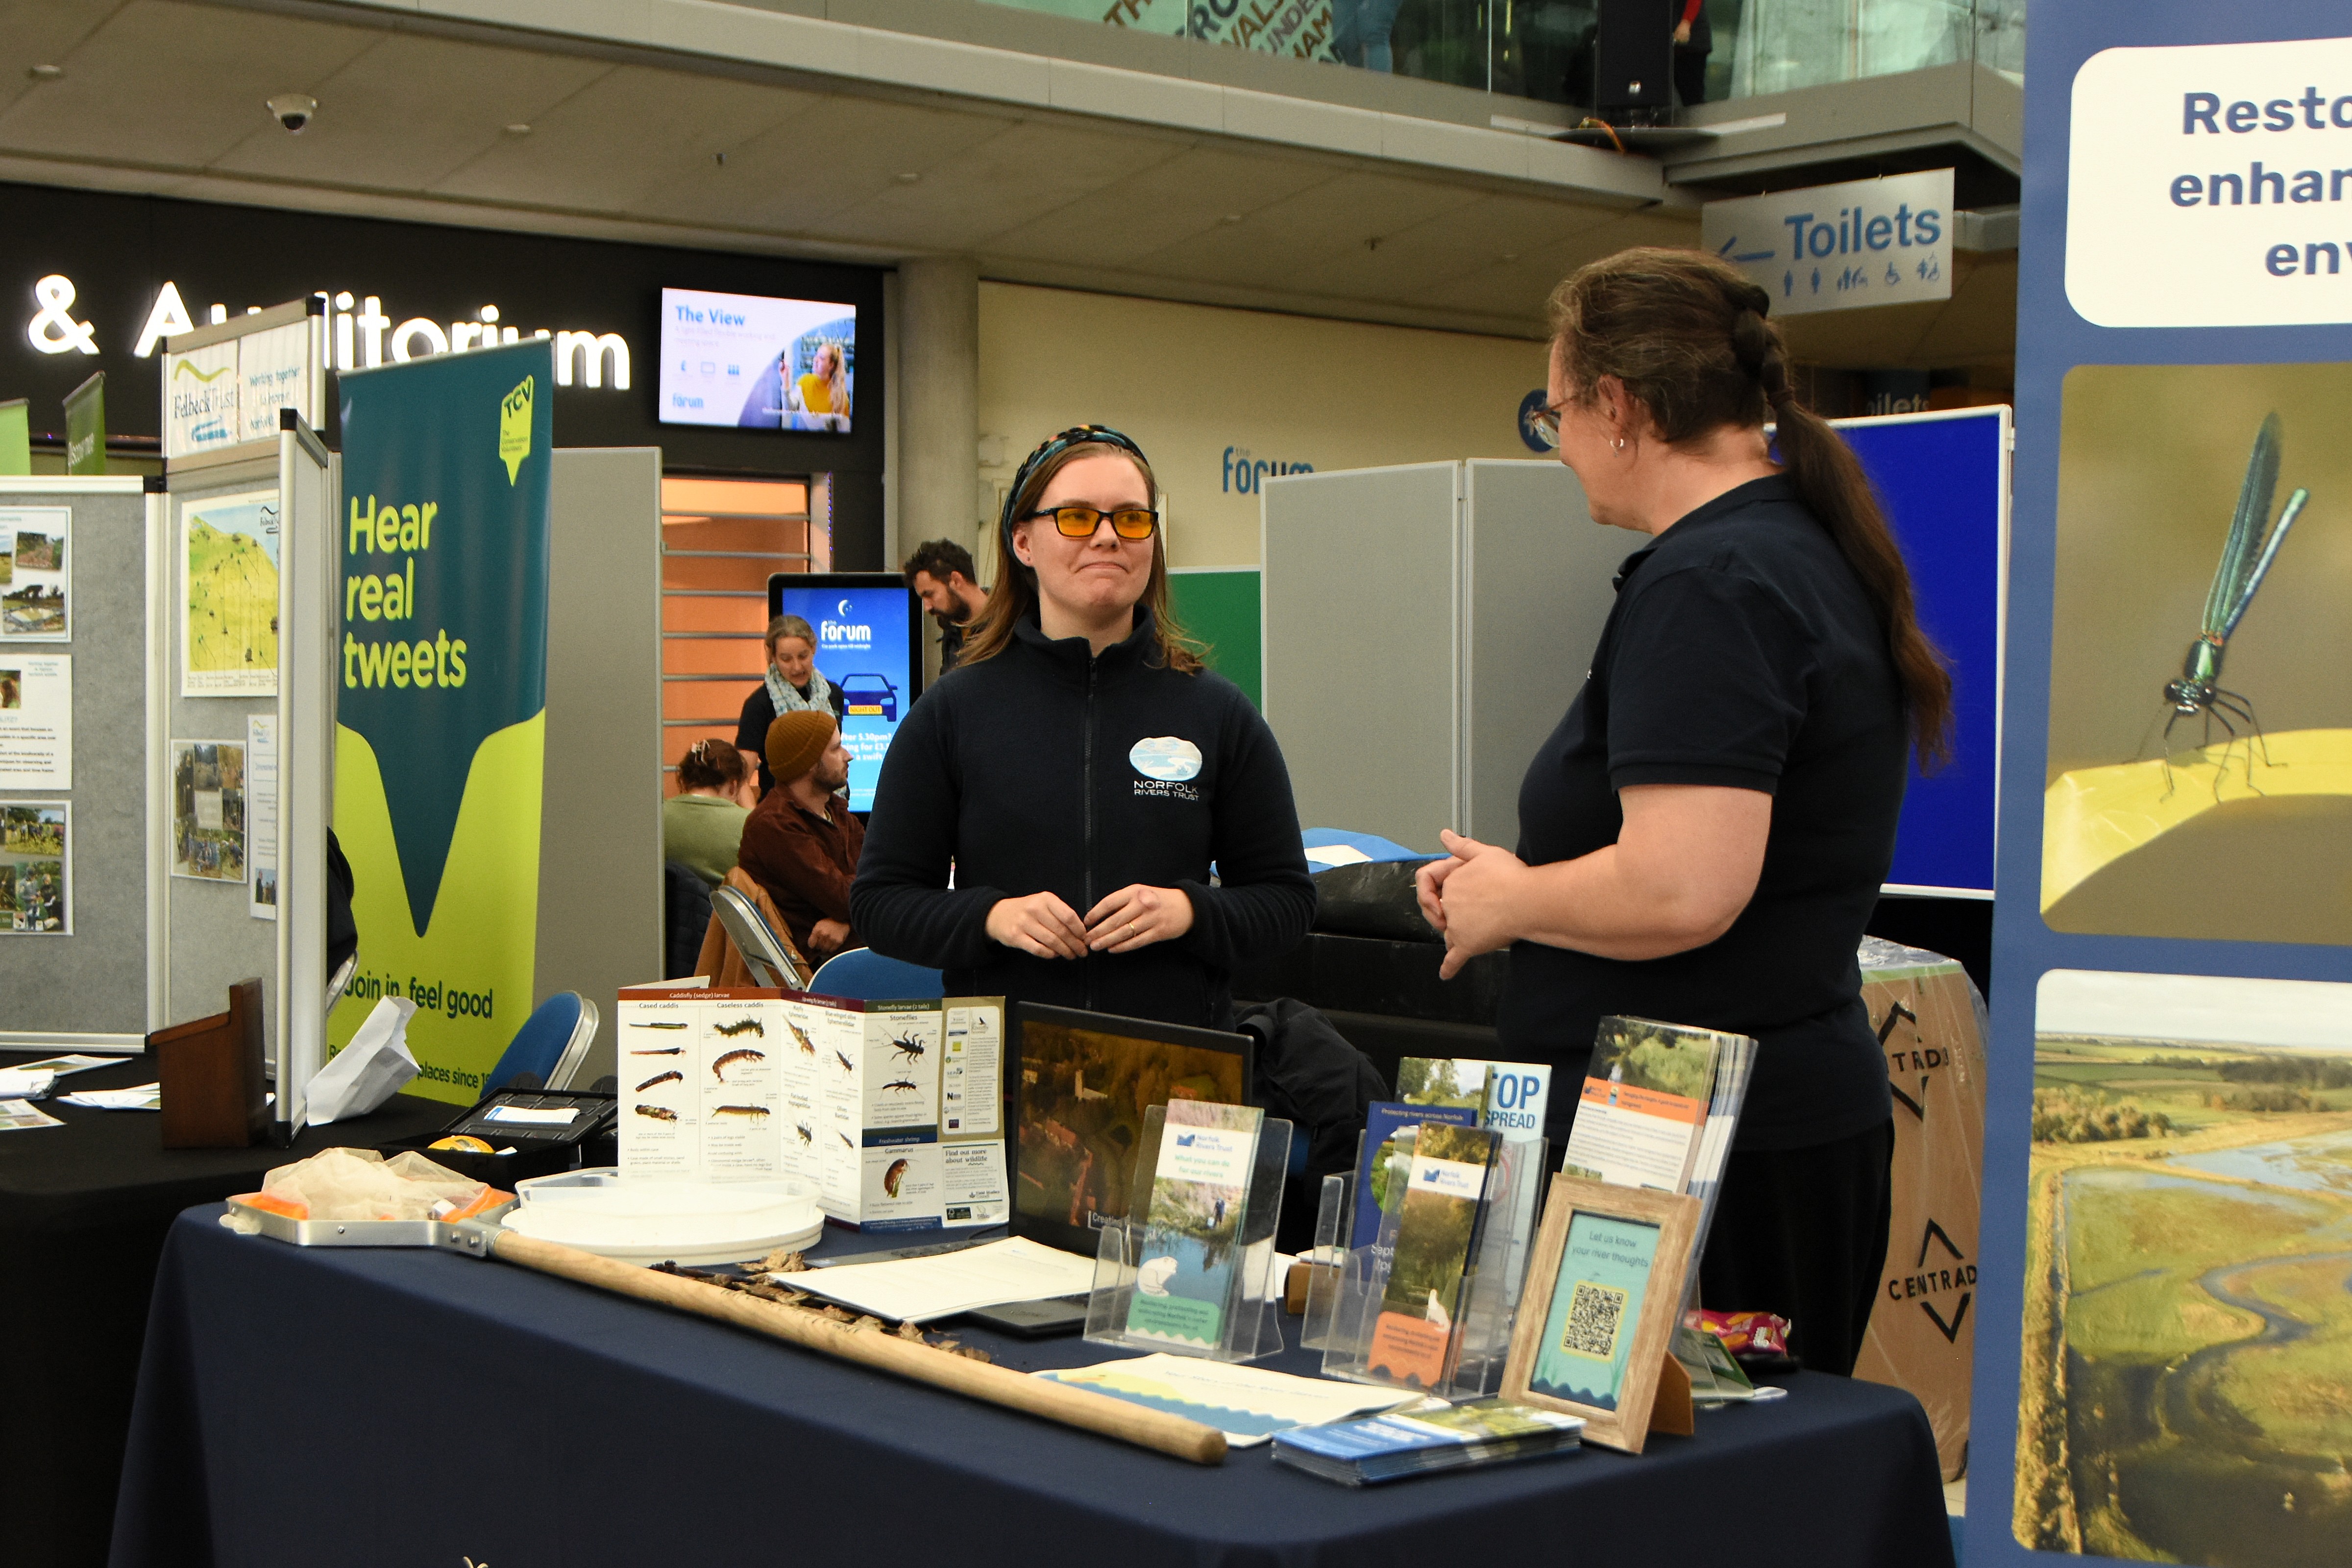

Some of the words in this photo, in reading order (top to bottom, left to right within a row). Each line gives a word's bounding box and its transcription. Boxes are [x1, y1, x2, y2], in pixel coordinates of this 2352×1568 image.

[2182, 86, 2352, 135] Resto
[2169, 161, 2352, 207] enhan
[1784, 202, 1941, 260] Toilets
[2265, 240, 2352, 277] en
[27, 274, 100, 355] &
[133, 281, 630, 390] Aitorim
[675, 305, 703, 323] The
[709, 309, 745, 326] View
[504, 380, 531, 418] TCV
[348, 493, 438, 555] Hear
[345, 556, 415, 622] real
[821, 620, 871, 641] forum
[343, 628, 467, 689] tweets
[840, 732, 857, 741] fter
[858, 733, 892, 743] 5.30pm?
[860, 742, 873, 751] for
[1133, 781, 1198, 794] NORFOLK
[1172, 791, 1200, 801] TRUST
[344, 970, 381, 1000] Join
[409, 976, 443, 1010] feel
[447, 988, 493, 1019] good
[416, 1060, 450, 1082] places
[452, 1067, 479, 1089] since
[1381, 1107, 1409, 1118] Protecting
[1443, 1113, 1464, 1122] Norfolk
[1589, 1230, 1603, 1241] Let
[1603, 1234, 1614, 1244] us
[1615, 1235, 1638, 1248] know
[1572, 1245, 1591, 1255] your
[1591, 1248, 1611, 1259] river
[1612, 1251, 1649, 1267] thoughts
